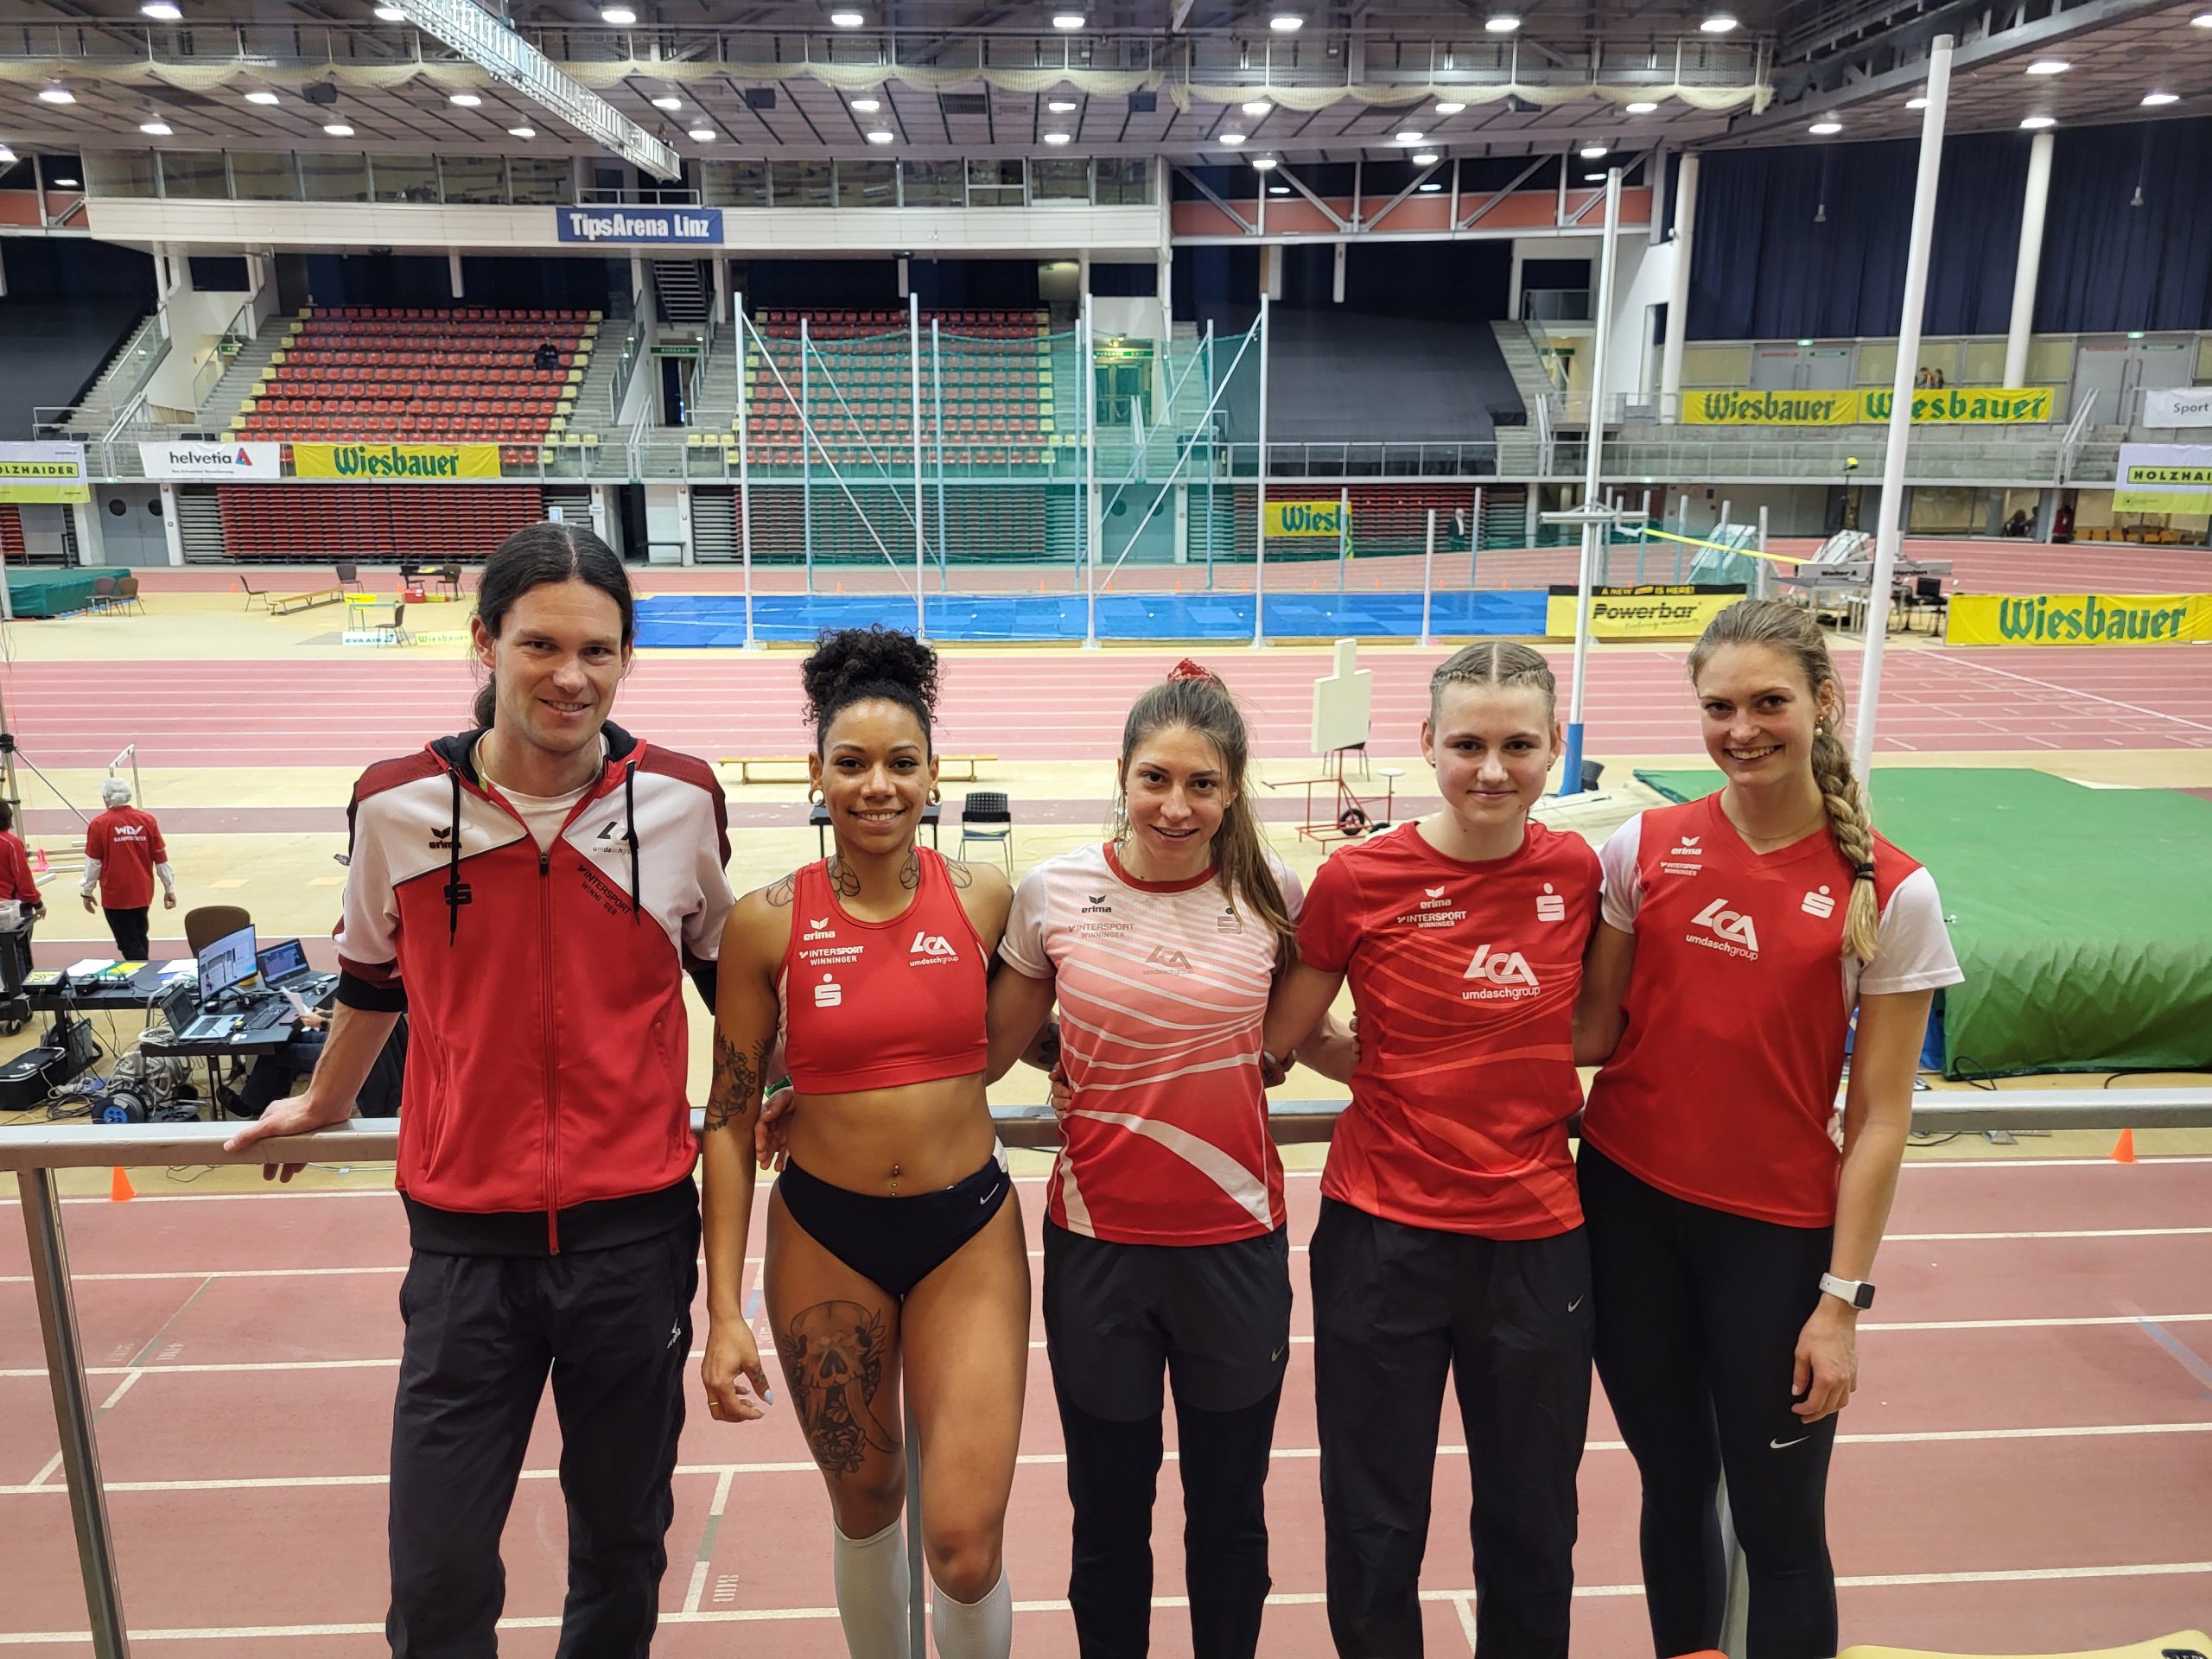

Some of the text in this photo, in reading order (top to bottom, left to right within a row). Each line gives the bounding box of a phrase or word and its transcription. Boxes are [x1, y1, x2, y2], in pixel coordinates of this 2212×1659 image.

[569, 213, 709, 241] TipsArena Linz
[1704, 391, 1835, 421] Wiesbauer
[1866, 391, 2047, 419] Wesbauer
[2173, 403, 2209, 415] Sport
[169, 451, 232, 464] helvetia
[334, 446, 460, 475] Wiesbauer
[0, 465, 74, 474] LZHAIDER
[1593, 602, 1698, 620] Powerbar
[1999, 595, 2187, 640] Wiesbauer
[1670, 847, 1703, 855] erima
[582, 881, 618, 917] WINNIGER
[1420, 898, 1452, 909] erima
[1690, 898, 1759, 952] LCA
[803, 931, 836, 941] erima
[910, 931, 957, 956] LCA
[1686, 934, 1759, 962] umdaschgroup
[810, 956, 857, 966] WINNINGER
[909, 956, 959, 967] umdaschgroup
[1463, 944, 1540, 986] LCA
[1462, 986, 1541, 1001] umdaschgroup
